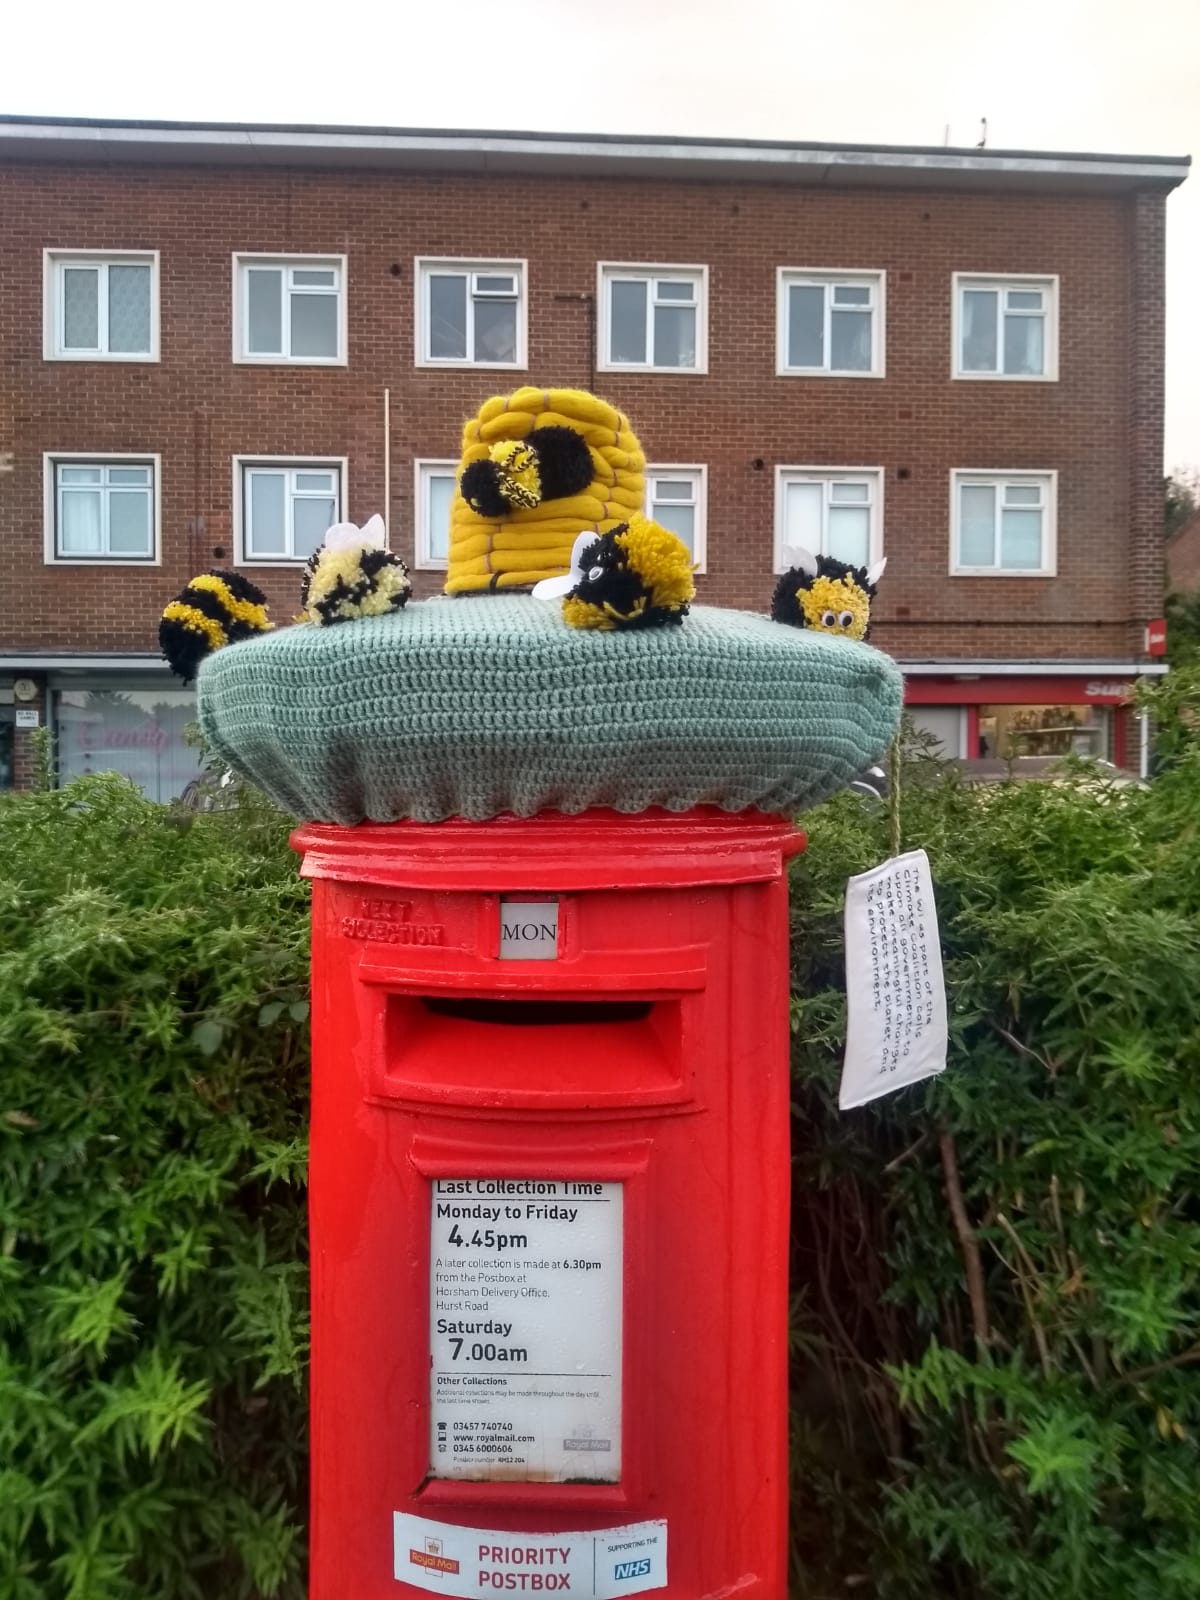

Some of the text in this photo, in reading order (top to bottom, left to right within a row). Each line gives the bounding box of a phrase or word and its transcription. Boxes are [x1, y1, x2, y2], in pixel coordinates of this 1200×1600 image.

[895, 871, 903, 908] upon
[502, 924, 557, 941] MON
[876, 902, 888, 958] protect
[919, 944, 929, 977] part
[925, 981, 932, 995] of
[437, 1179, 603, 1195] Last Collection Time
[437, 1203, 578, 1222] Monday to Friday
[448, 1224, 528, 1251] 4.45pm
[436, 1259, 602, 1271] A later collection is made at 6.30pm
[436, 1273, 527, 1283] from the Postbox at
[436, 1287, 479, 1297] Horsham
[481, 1288, 519, 1299] Delivery
[436, 1301, 489, 1311] Hurst Road
[437, 1318, 512, 1337] Saturday
[449, 1337, 528, 1362] 7.00am
[437, 1376, 508, 1386] Other Collections
[453, 1422, 513, 1431] 03457 740740
[453, 1433, 535, 1443] www.royalmail.com
[453, 1444, 513, 1453] 0345 6000606
[607, 1536, 658, 1552] SUPPORTING THE
[412, 1552, 457, 1571] Royal Mail
[478, 1545, 571, 1565] PRIORITY
[615, 1559, 650, 1579] NHS
[478, 1570, 571, 1590] POSTBOX
